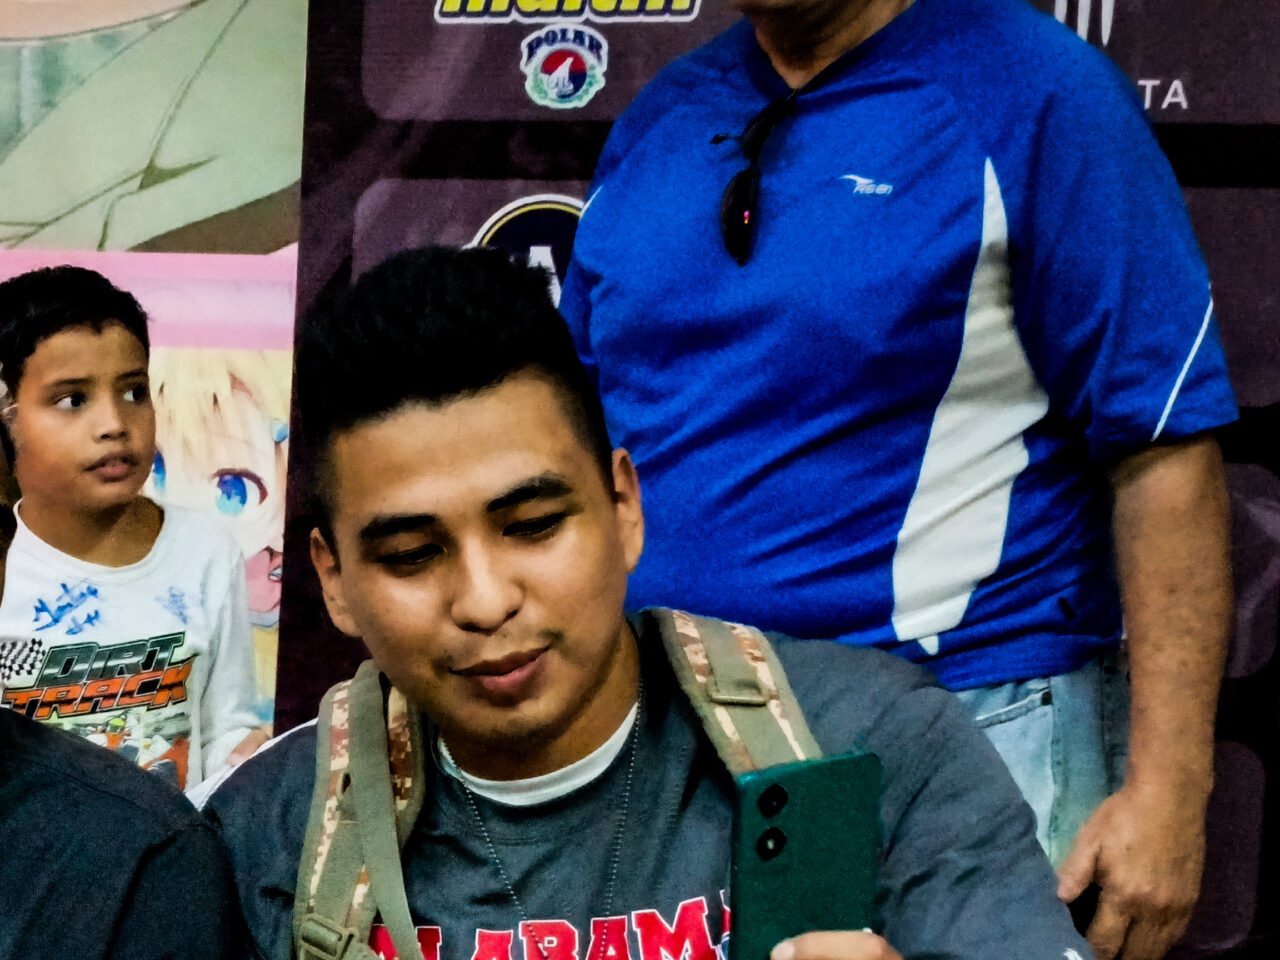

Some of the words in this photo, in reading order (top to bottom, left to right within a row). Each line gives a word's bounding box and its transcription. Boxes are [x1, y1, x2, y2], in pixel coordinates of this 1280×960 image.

[526, 28, 604, 62] POLAR
[1, 658, 194, 720] TRACK
[33, 631, 186, 689] DIRT
